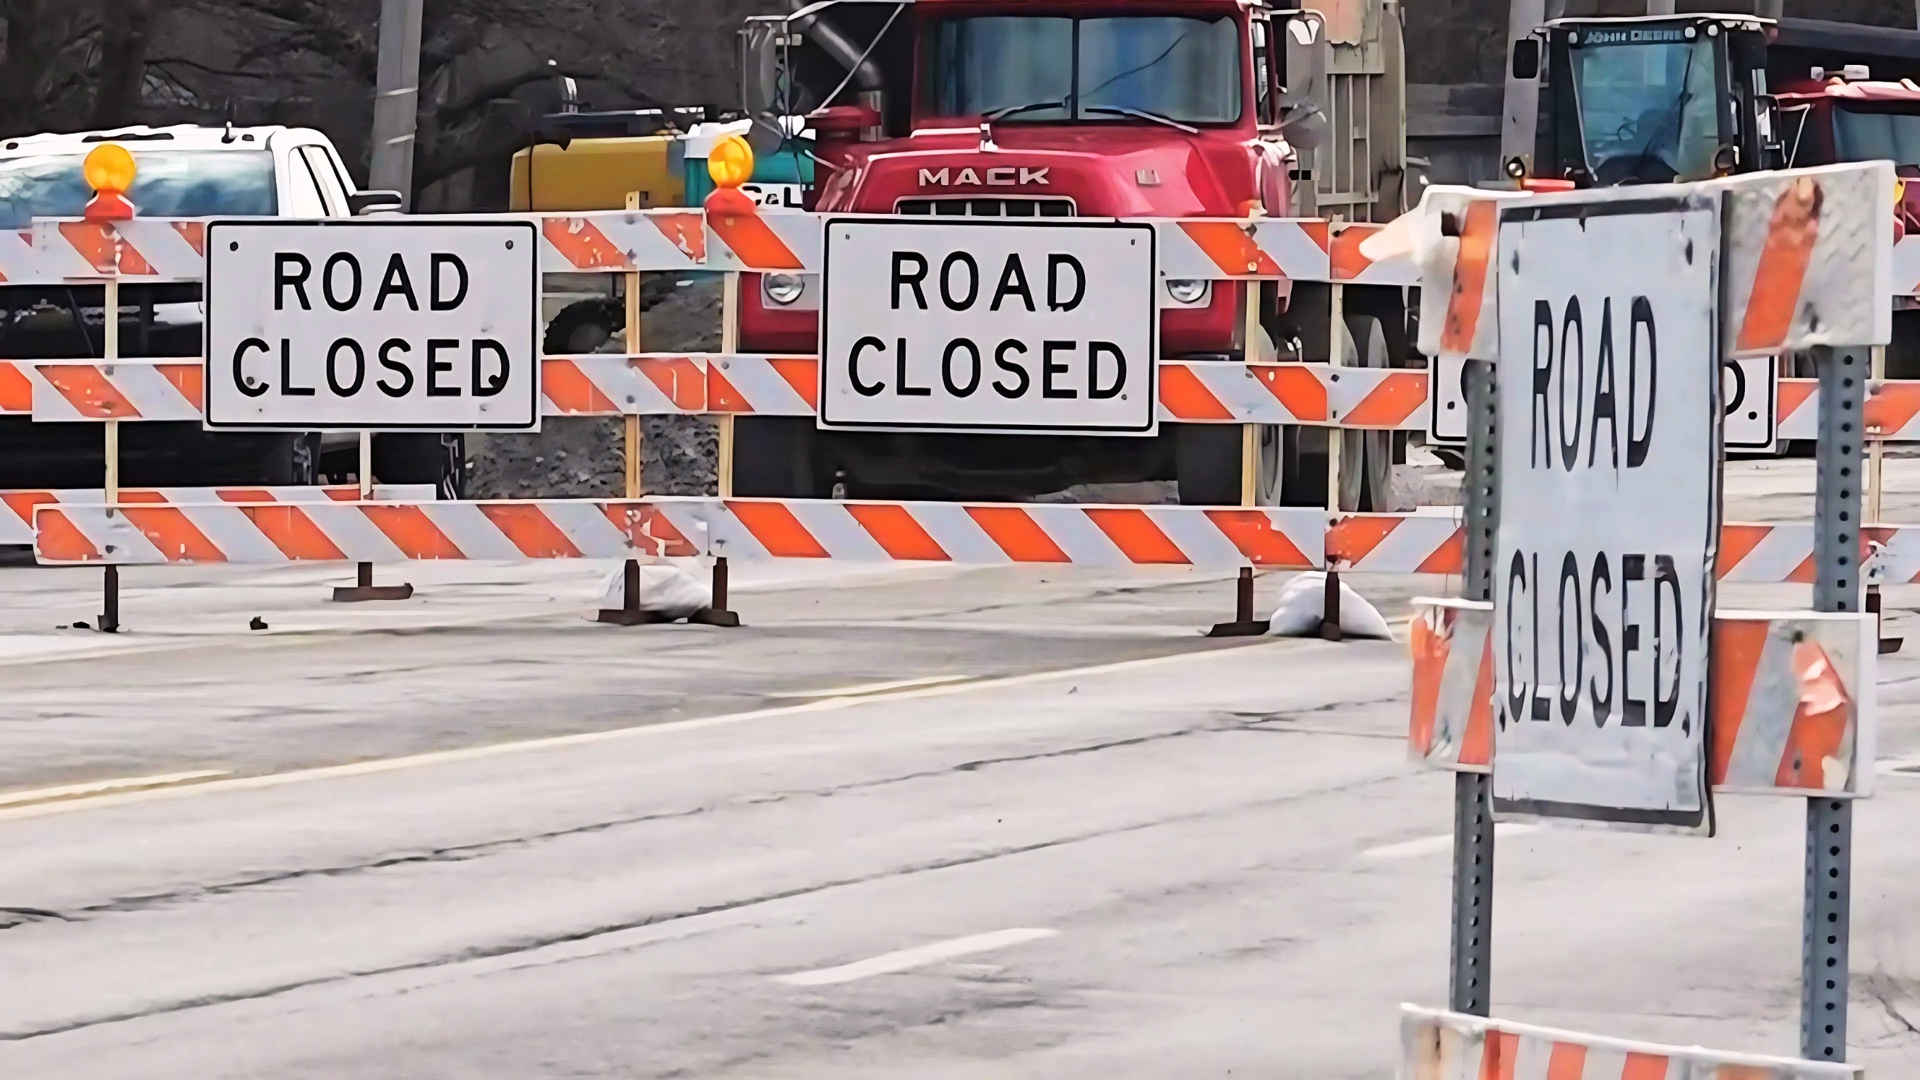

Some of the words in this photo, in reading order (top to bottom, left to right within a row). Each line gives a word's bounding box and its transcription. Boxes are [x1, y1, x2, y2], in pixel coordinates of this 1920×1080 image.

[918, 167, 1050, 186] MACK
[274, 252, 469, 312] ROAD
[890, 251, 1086, 312] ROAD
[232, 337, 511, 397] CLOSED
[848, 336, 1128, 400] CLOSED
[1531, 294, 1657, 472] ROAD
[1507, 548, 1683, 728] CLOSED
